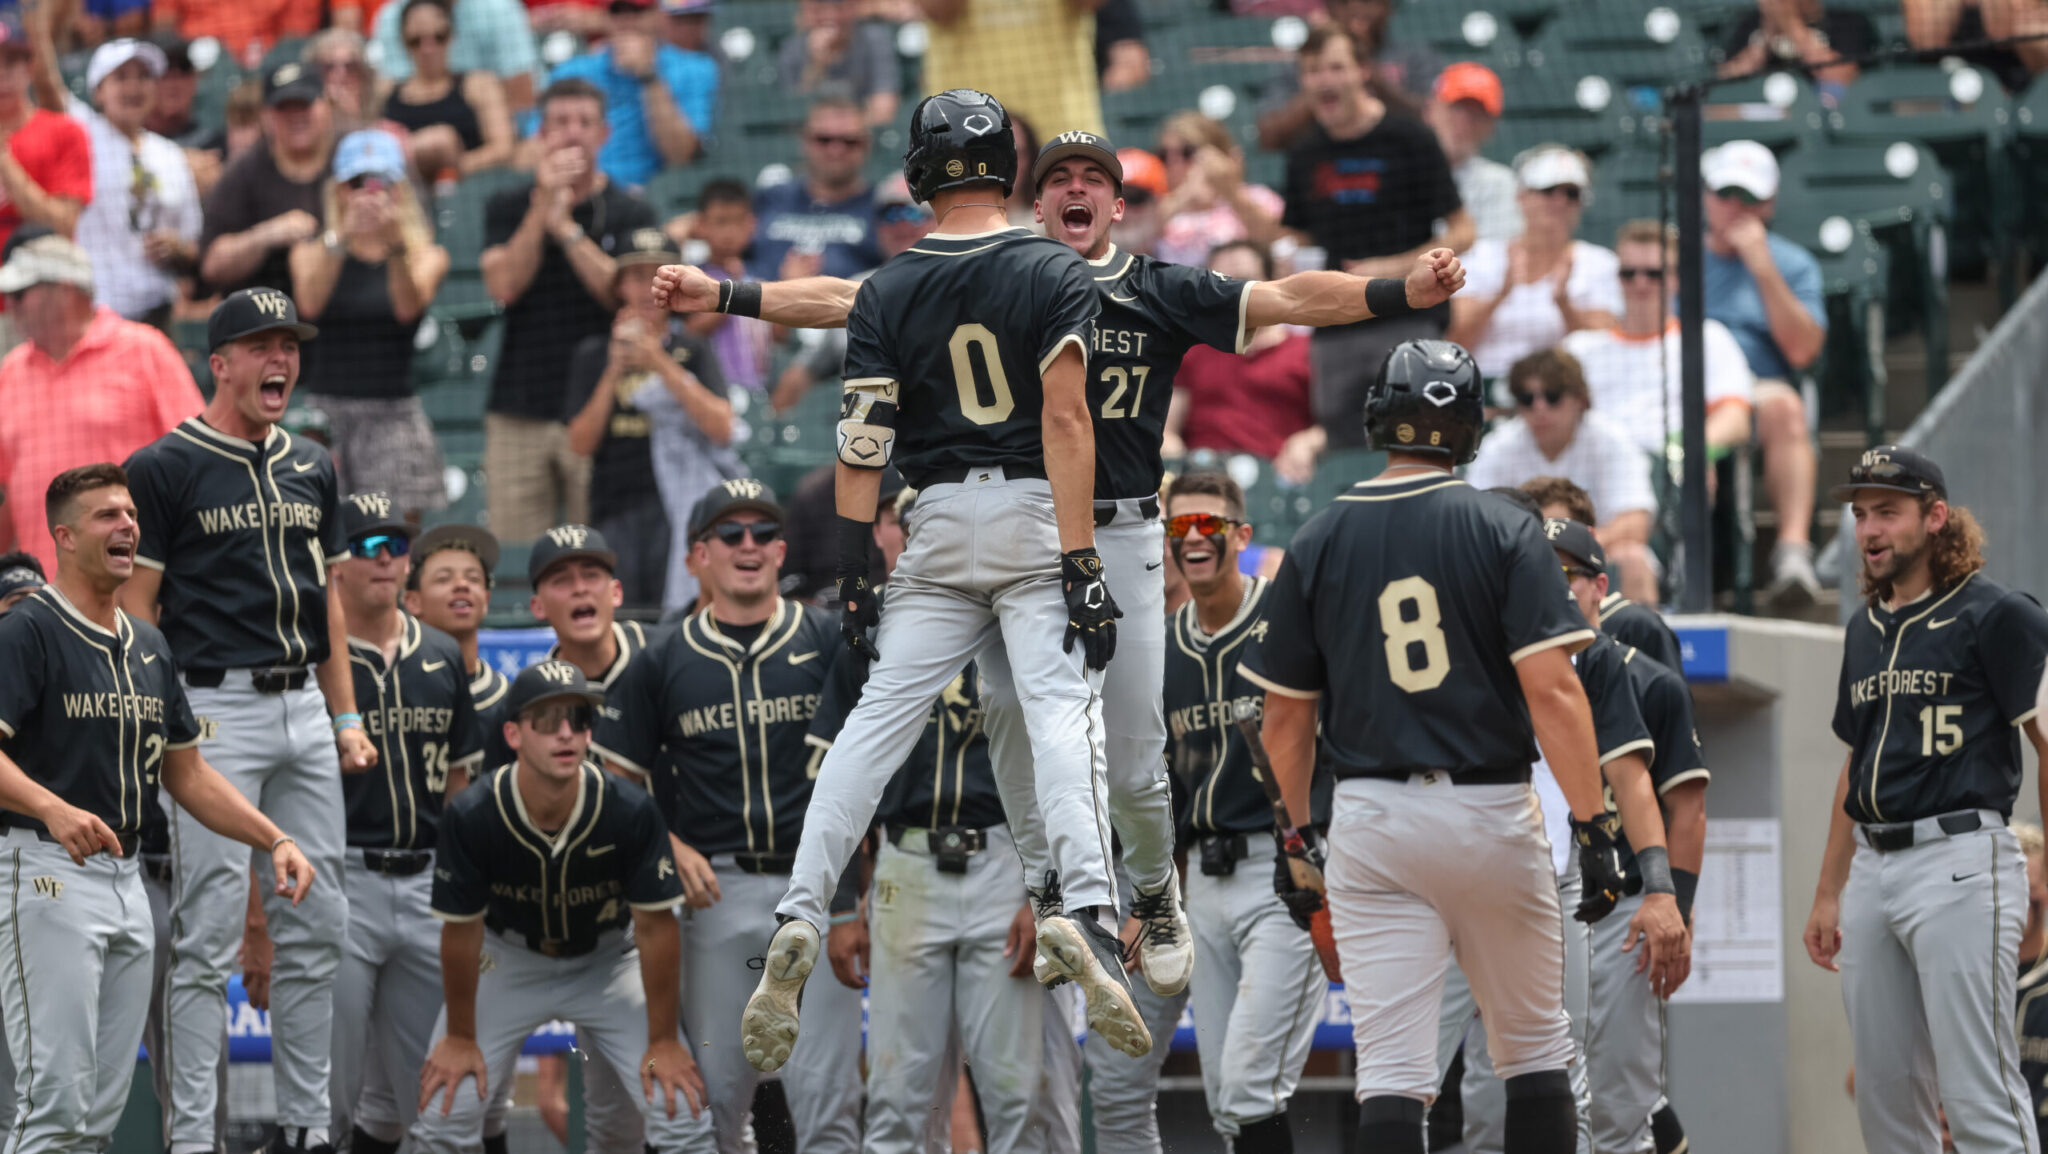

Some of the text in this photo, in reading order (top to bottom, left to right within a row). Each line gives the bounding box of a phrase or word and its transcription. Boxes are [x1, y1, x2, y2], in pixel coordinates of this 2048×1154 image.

[1057, 130, 1097, 144] WF
[978, 162, 987, 176] 0
[252, 292, 288, 320] WF
[1093, 327, 1148, 357] REST
[949, 323, 1015, 425] 0
[1100, 366, 1151, 419] 27
[1430, 431, 1441, 446] 8
[723, 478, 763, 500] WF
[197, 502, 322, 535] WAKE FORES
[354, 493, 391, 519] WF
[548, 525, 589, 549] WF
[1377, 575, 1451, 694] 8
[536, 660, 575, 686] WF
[1879, 669, 1954, 697] FOREST
[63, 692, 164, 724] WAKE FORES
[388, 706, 454, 734] FOREST
[678, 694, 823, 738] WAKE FORES
[1919, 705, 1963, 757] 15
